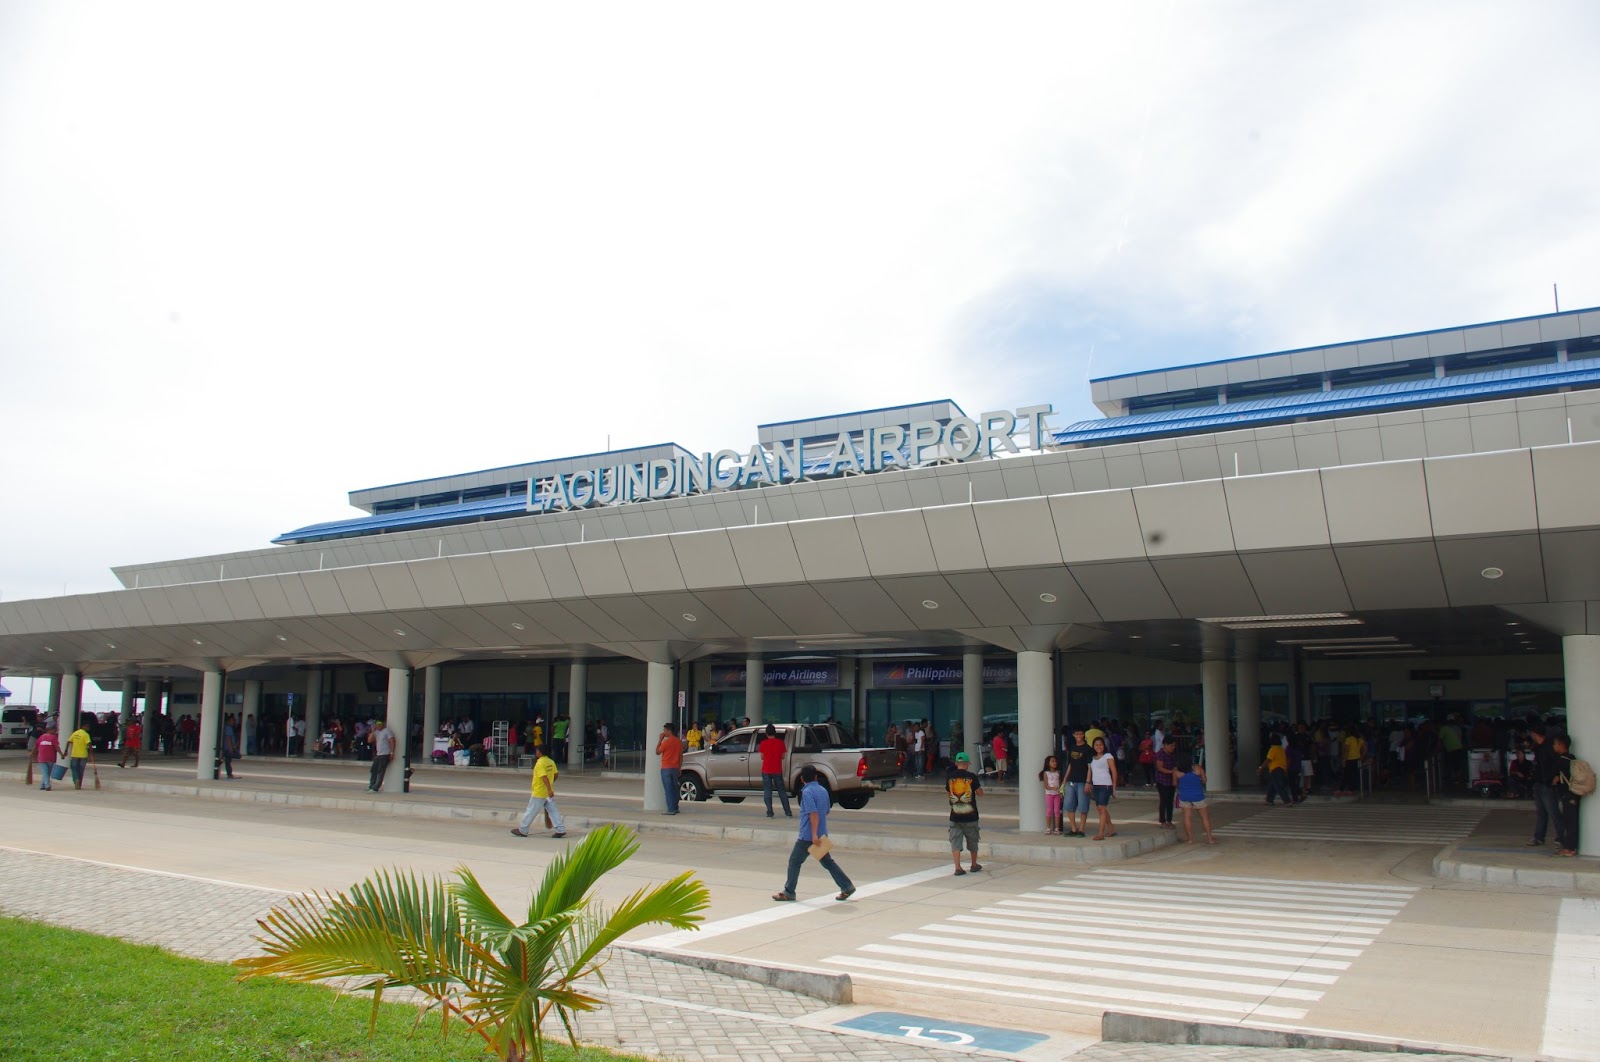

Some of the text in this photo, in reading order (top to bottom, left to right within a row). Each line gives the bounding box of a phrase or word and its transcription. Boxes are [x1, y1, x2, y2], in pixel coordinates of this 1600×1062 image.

[526, 404, 1052, 512] LAGUINDINGAN AIRPORT
[788, 669, 828, 680] Airlines
[907, 666, 1012, 681] Philippine lines
